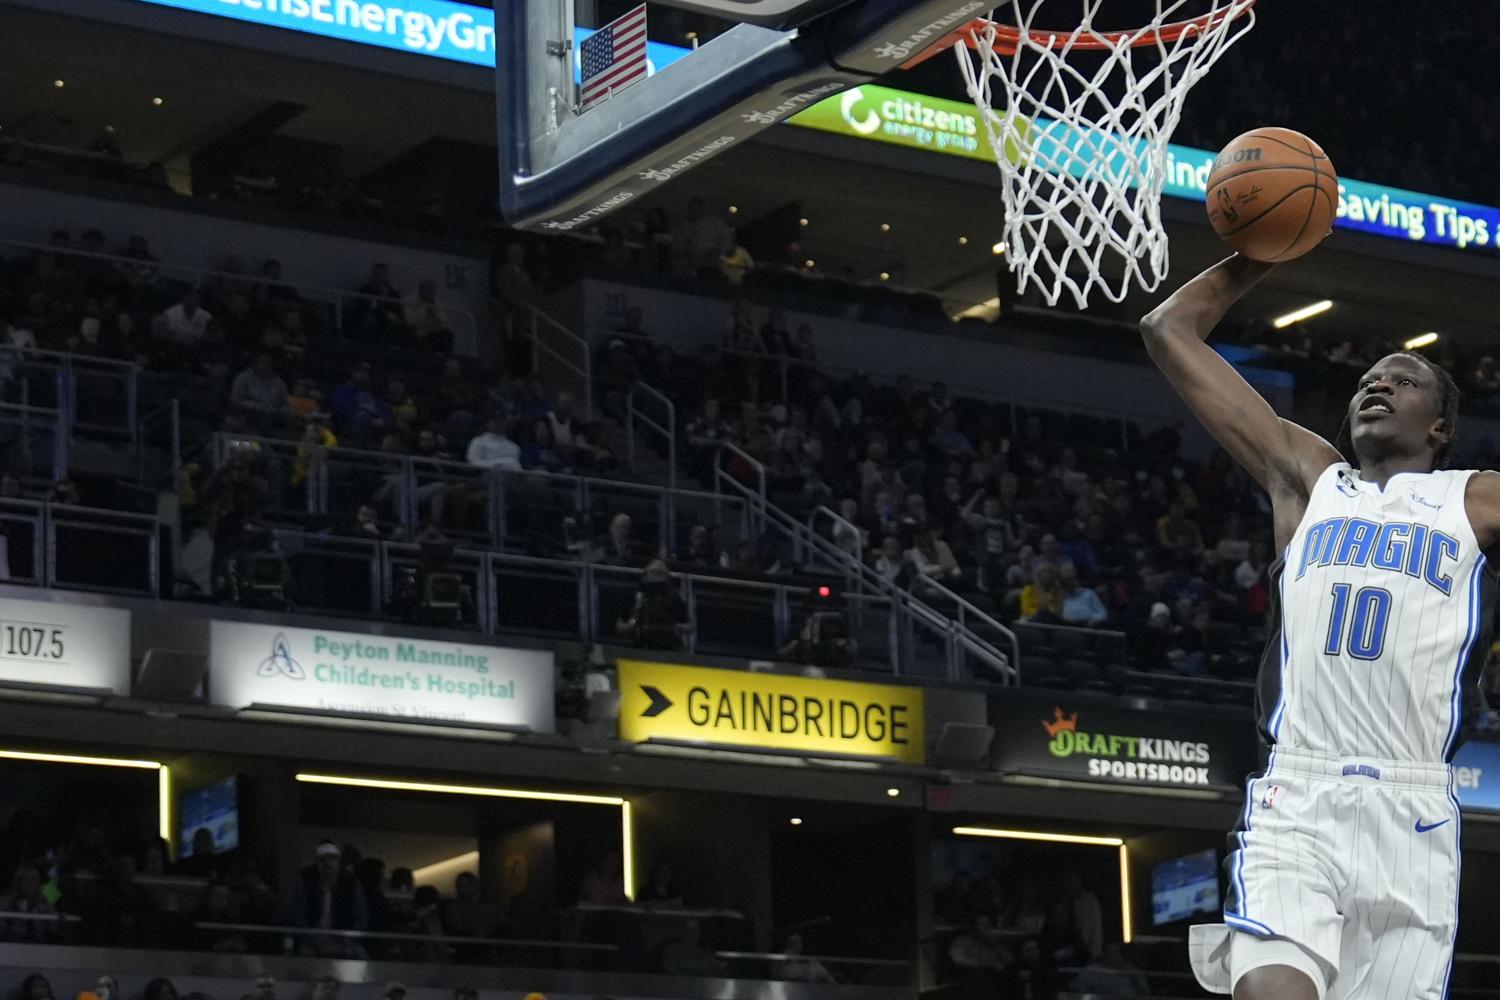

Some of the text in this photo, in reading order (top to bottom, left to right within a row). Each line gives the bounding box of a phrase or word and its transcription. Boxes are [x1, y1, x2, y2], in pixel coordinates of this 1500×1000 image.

[881, 97, 977, 136] citizens
[1430, 204, 1488, 248] Tips
[1295, 516, 1460, 597] MAGIC
[1325, 583, 1392, 660] 10
[6, 626, 64, 659] 107.5
[314, 636, 489, 673] Peyton Manning
[314, 664, 515, 699] Children's Hospital
[688, 688, 908, 744] GAINBRIDGE
[1048, 729, 1210, 764] DRAFTKINGS
[1089, 758, 1210, 785] SPORTSBOOK
